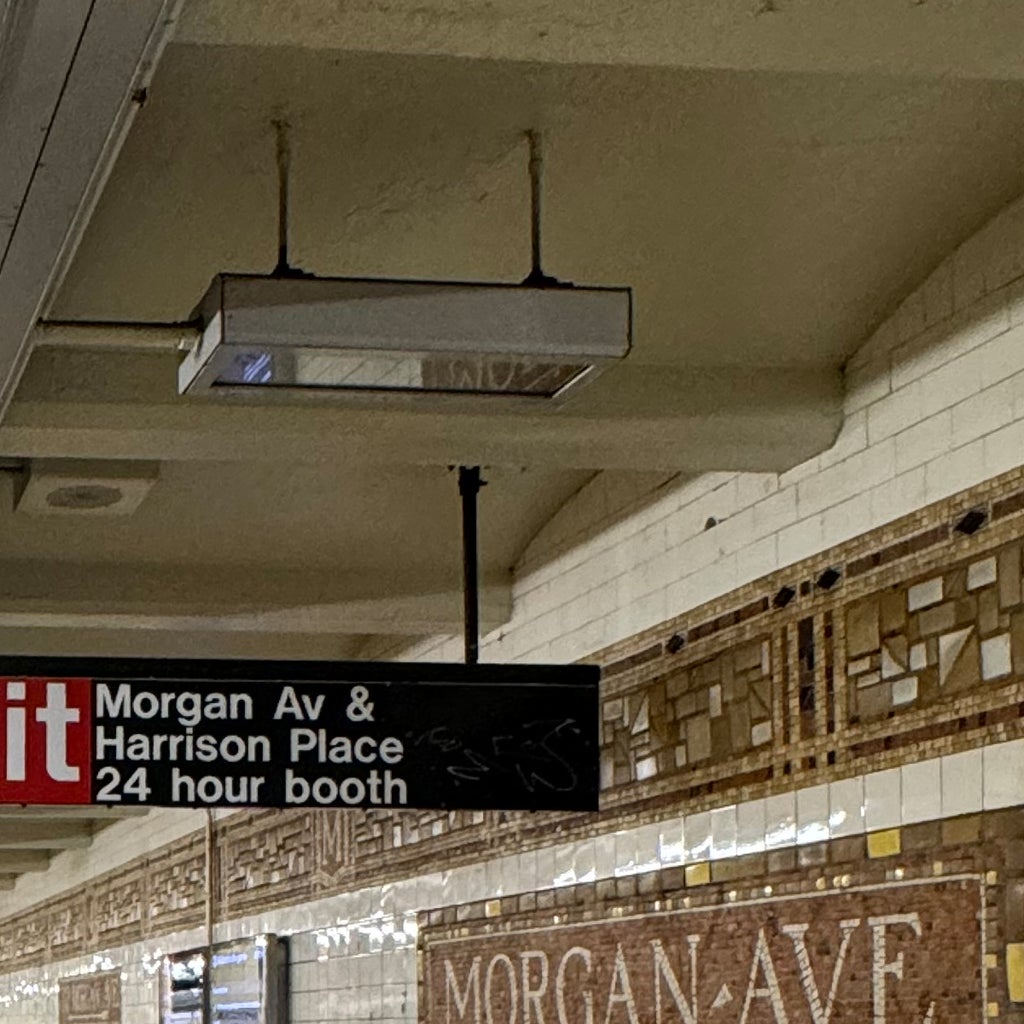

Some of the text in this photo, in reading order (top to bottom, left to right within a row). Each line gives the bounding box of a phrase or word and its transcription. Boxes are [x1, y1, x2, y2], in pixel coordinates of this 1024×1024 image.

[95, 683, 375, 727] Morgan Av &
[95, 725, 272, 763] Harrison
[289, 727, 405, 764] Place
[95, 766, 408, 805] 24 hour booth
